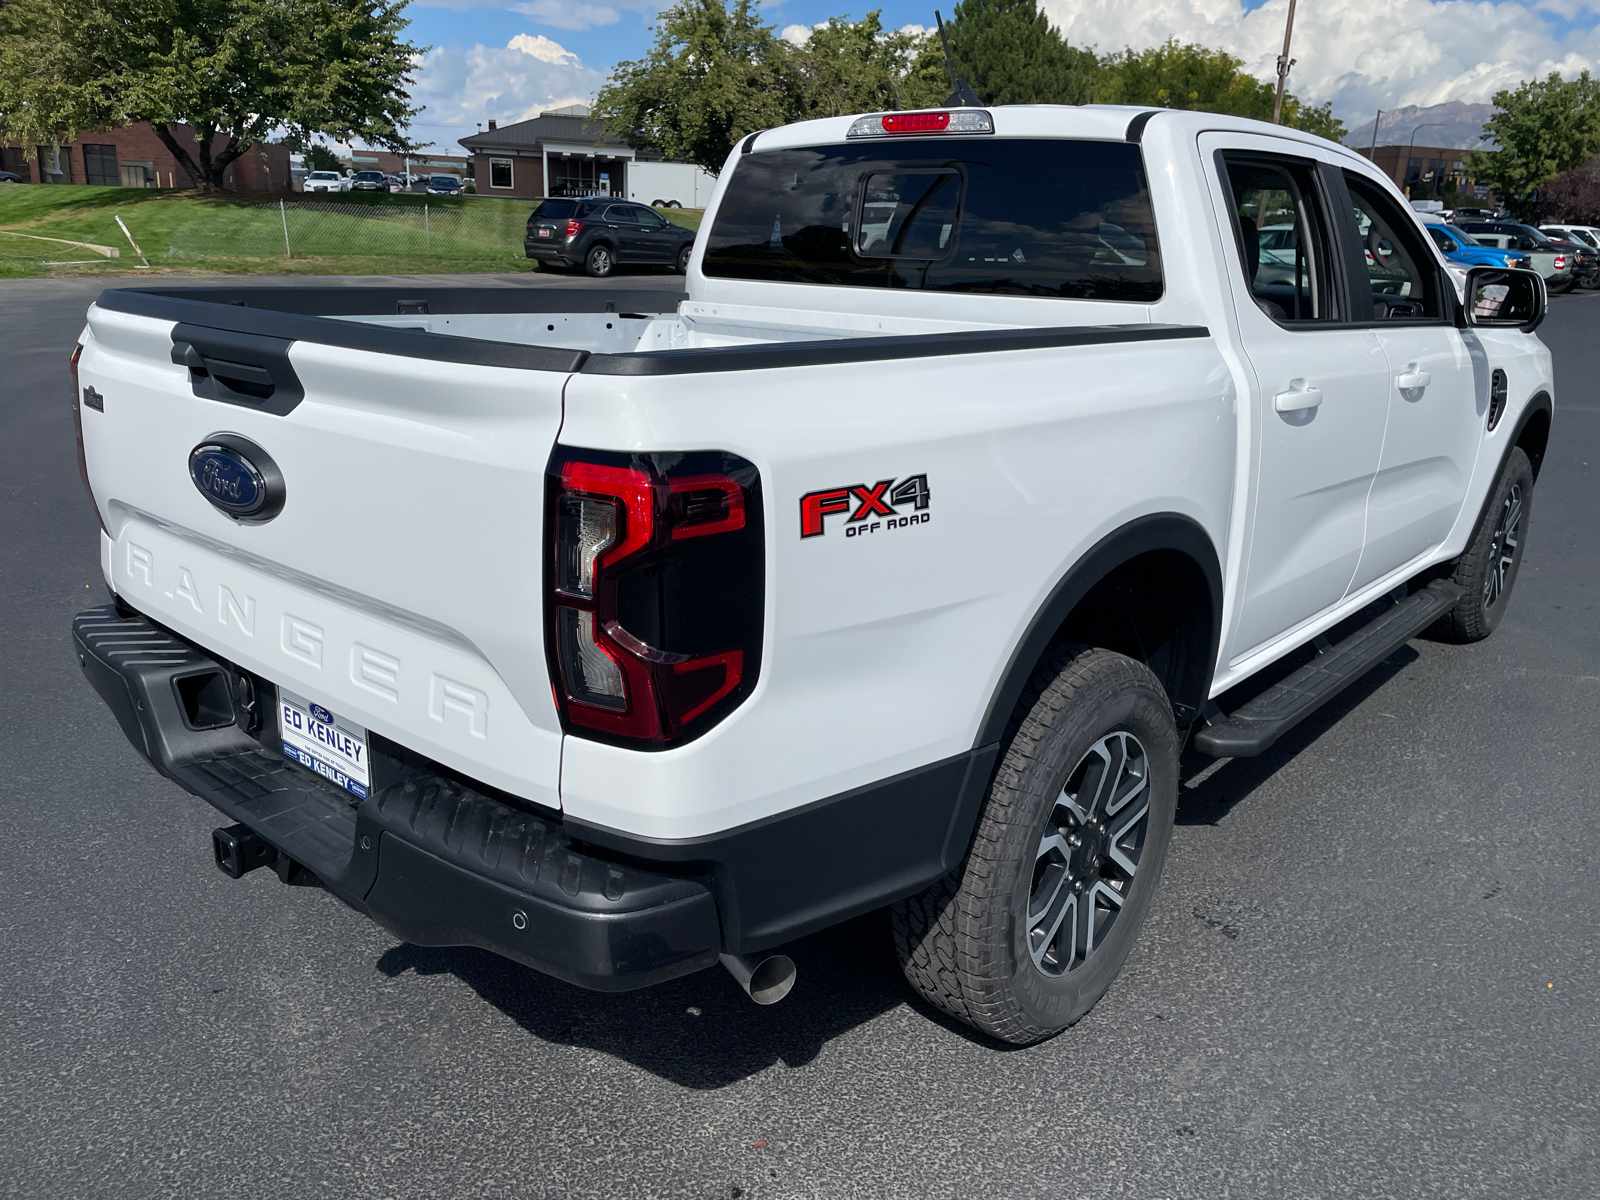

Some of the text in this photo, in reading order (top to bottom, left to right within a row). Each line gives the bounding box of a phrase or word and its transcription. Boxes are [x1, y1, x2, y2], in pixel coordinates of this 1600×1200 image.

[202, 458, 242, 499] Ford
[798, 472, 931, 540] FX4
[846, 513, 930, 538] OFF ROAD
[126, 540, 489, 740] RANGER
[284, 705, 362, 762] ED KENLEY
[313, 705, 329, 723] Ford
[299, 752, 350, 789] ED KENLEY
